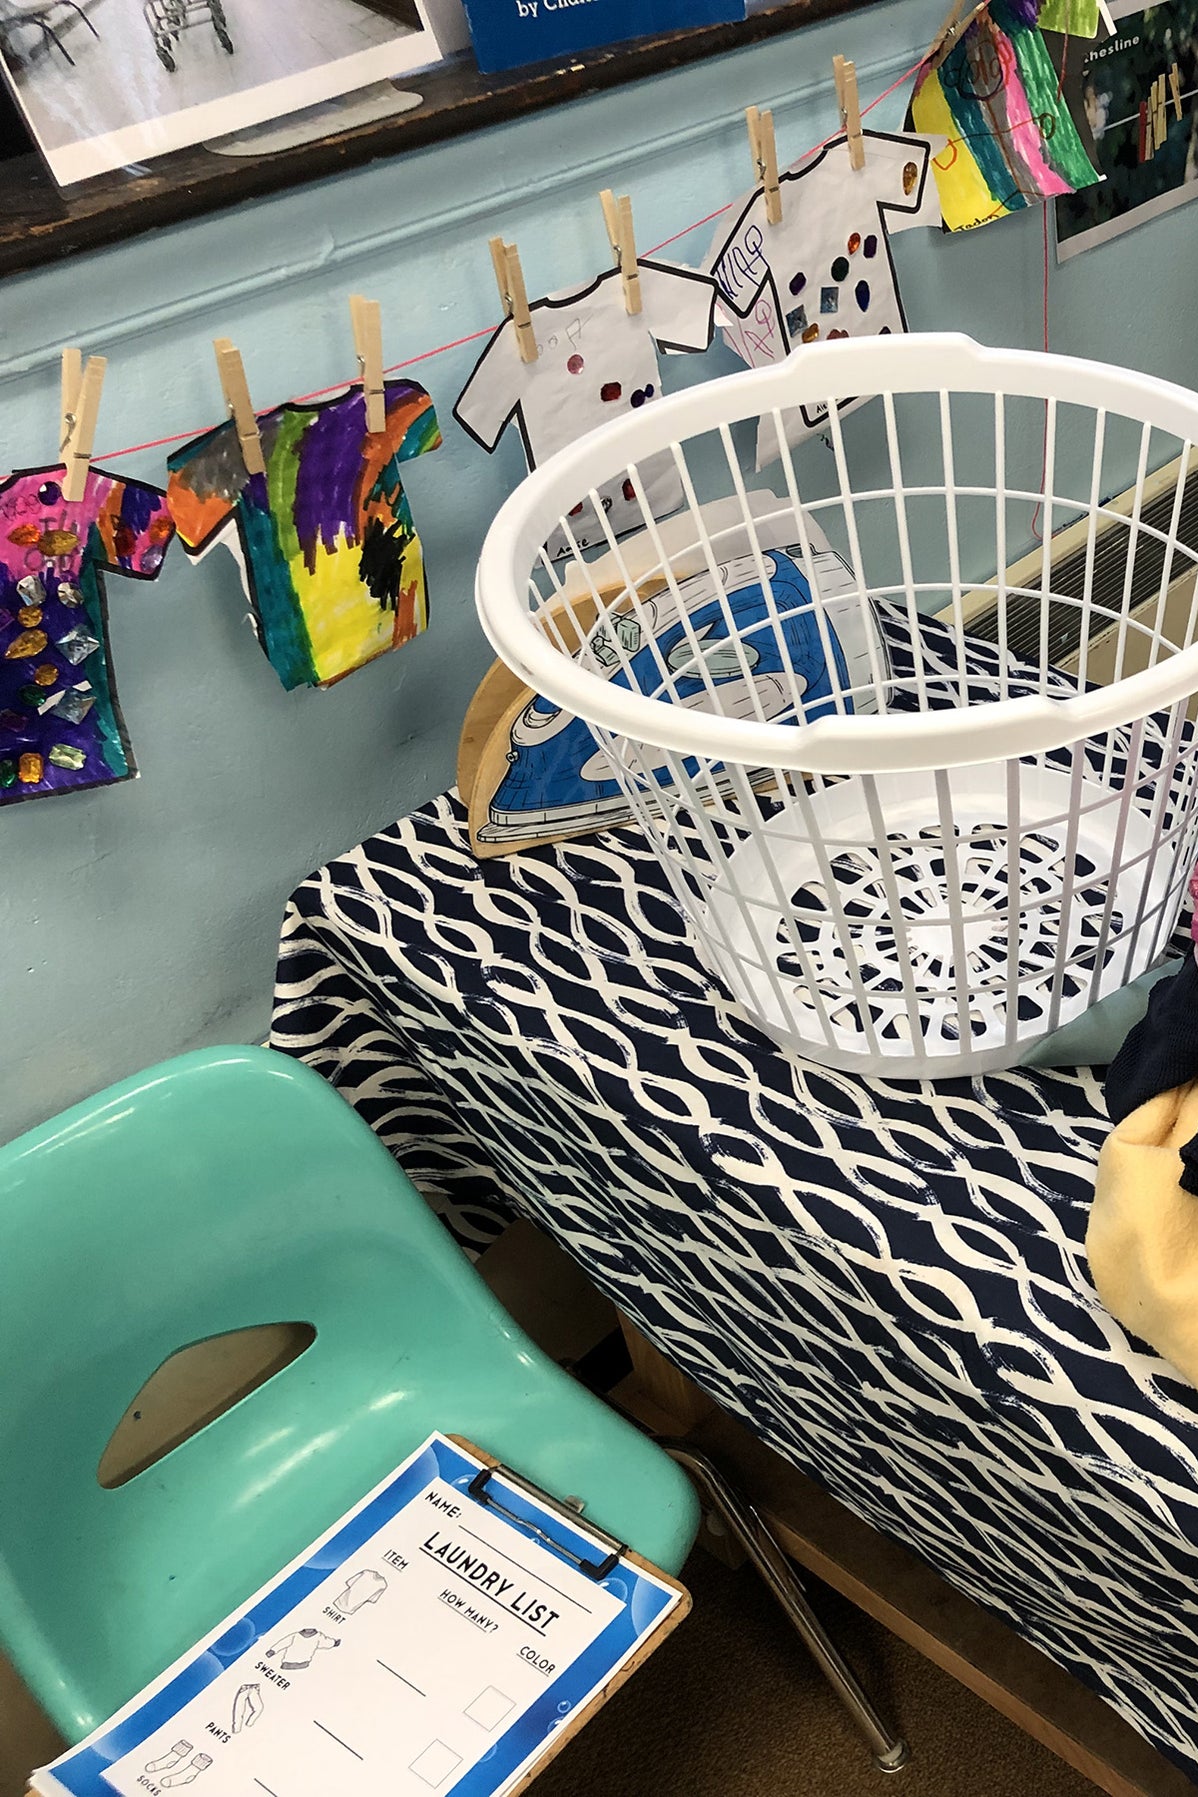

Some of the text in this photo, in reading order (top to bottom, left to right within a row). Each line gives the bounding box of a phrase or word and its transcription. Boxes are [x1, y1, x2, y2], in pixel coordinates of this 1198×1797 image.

[516, 0, 539, 18] by
[1084, 35, 1140, 63] hesline
[425, 1491, 462, 1519] NAME:
[382, 1549, 409, 1570] ITEM
[423, 1531, 560, 1629] LAUNDRY LIST
[322, 1606, 346, 1625] SHIRT
[439, 1588, 499, 1633] HOW MANY?
[519, 1645, 556, 1675] COLOR
[254, 1661, 291, 1691] SWEATER
[205, 1721, 232, 1744] PANTS
[136, 1774, 162, 1797] SOCKS
